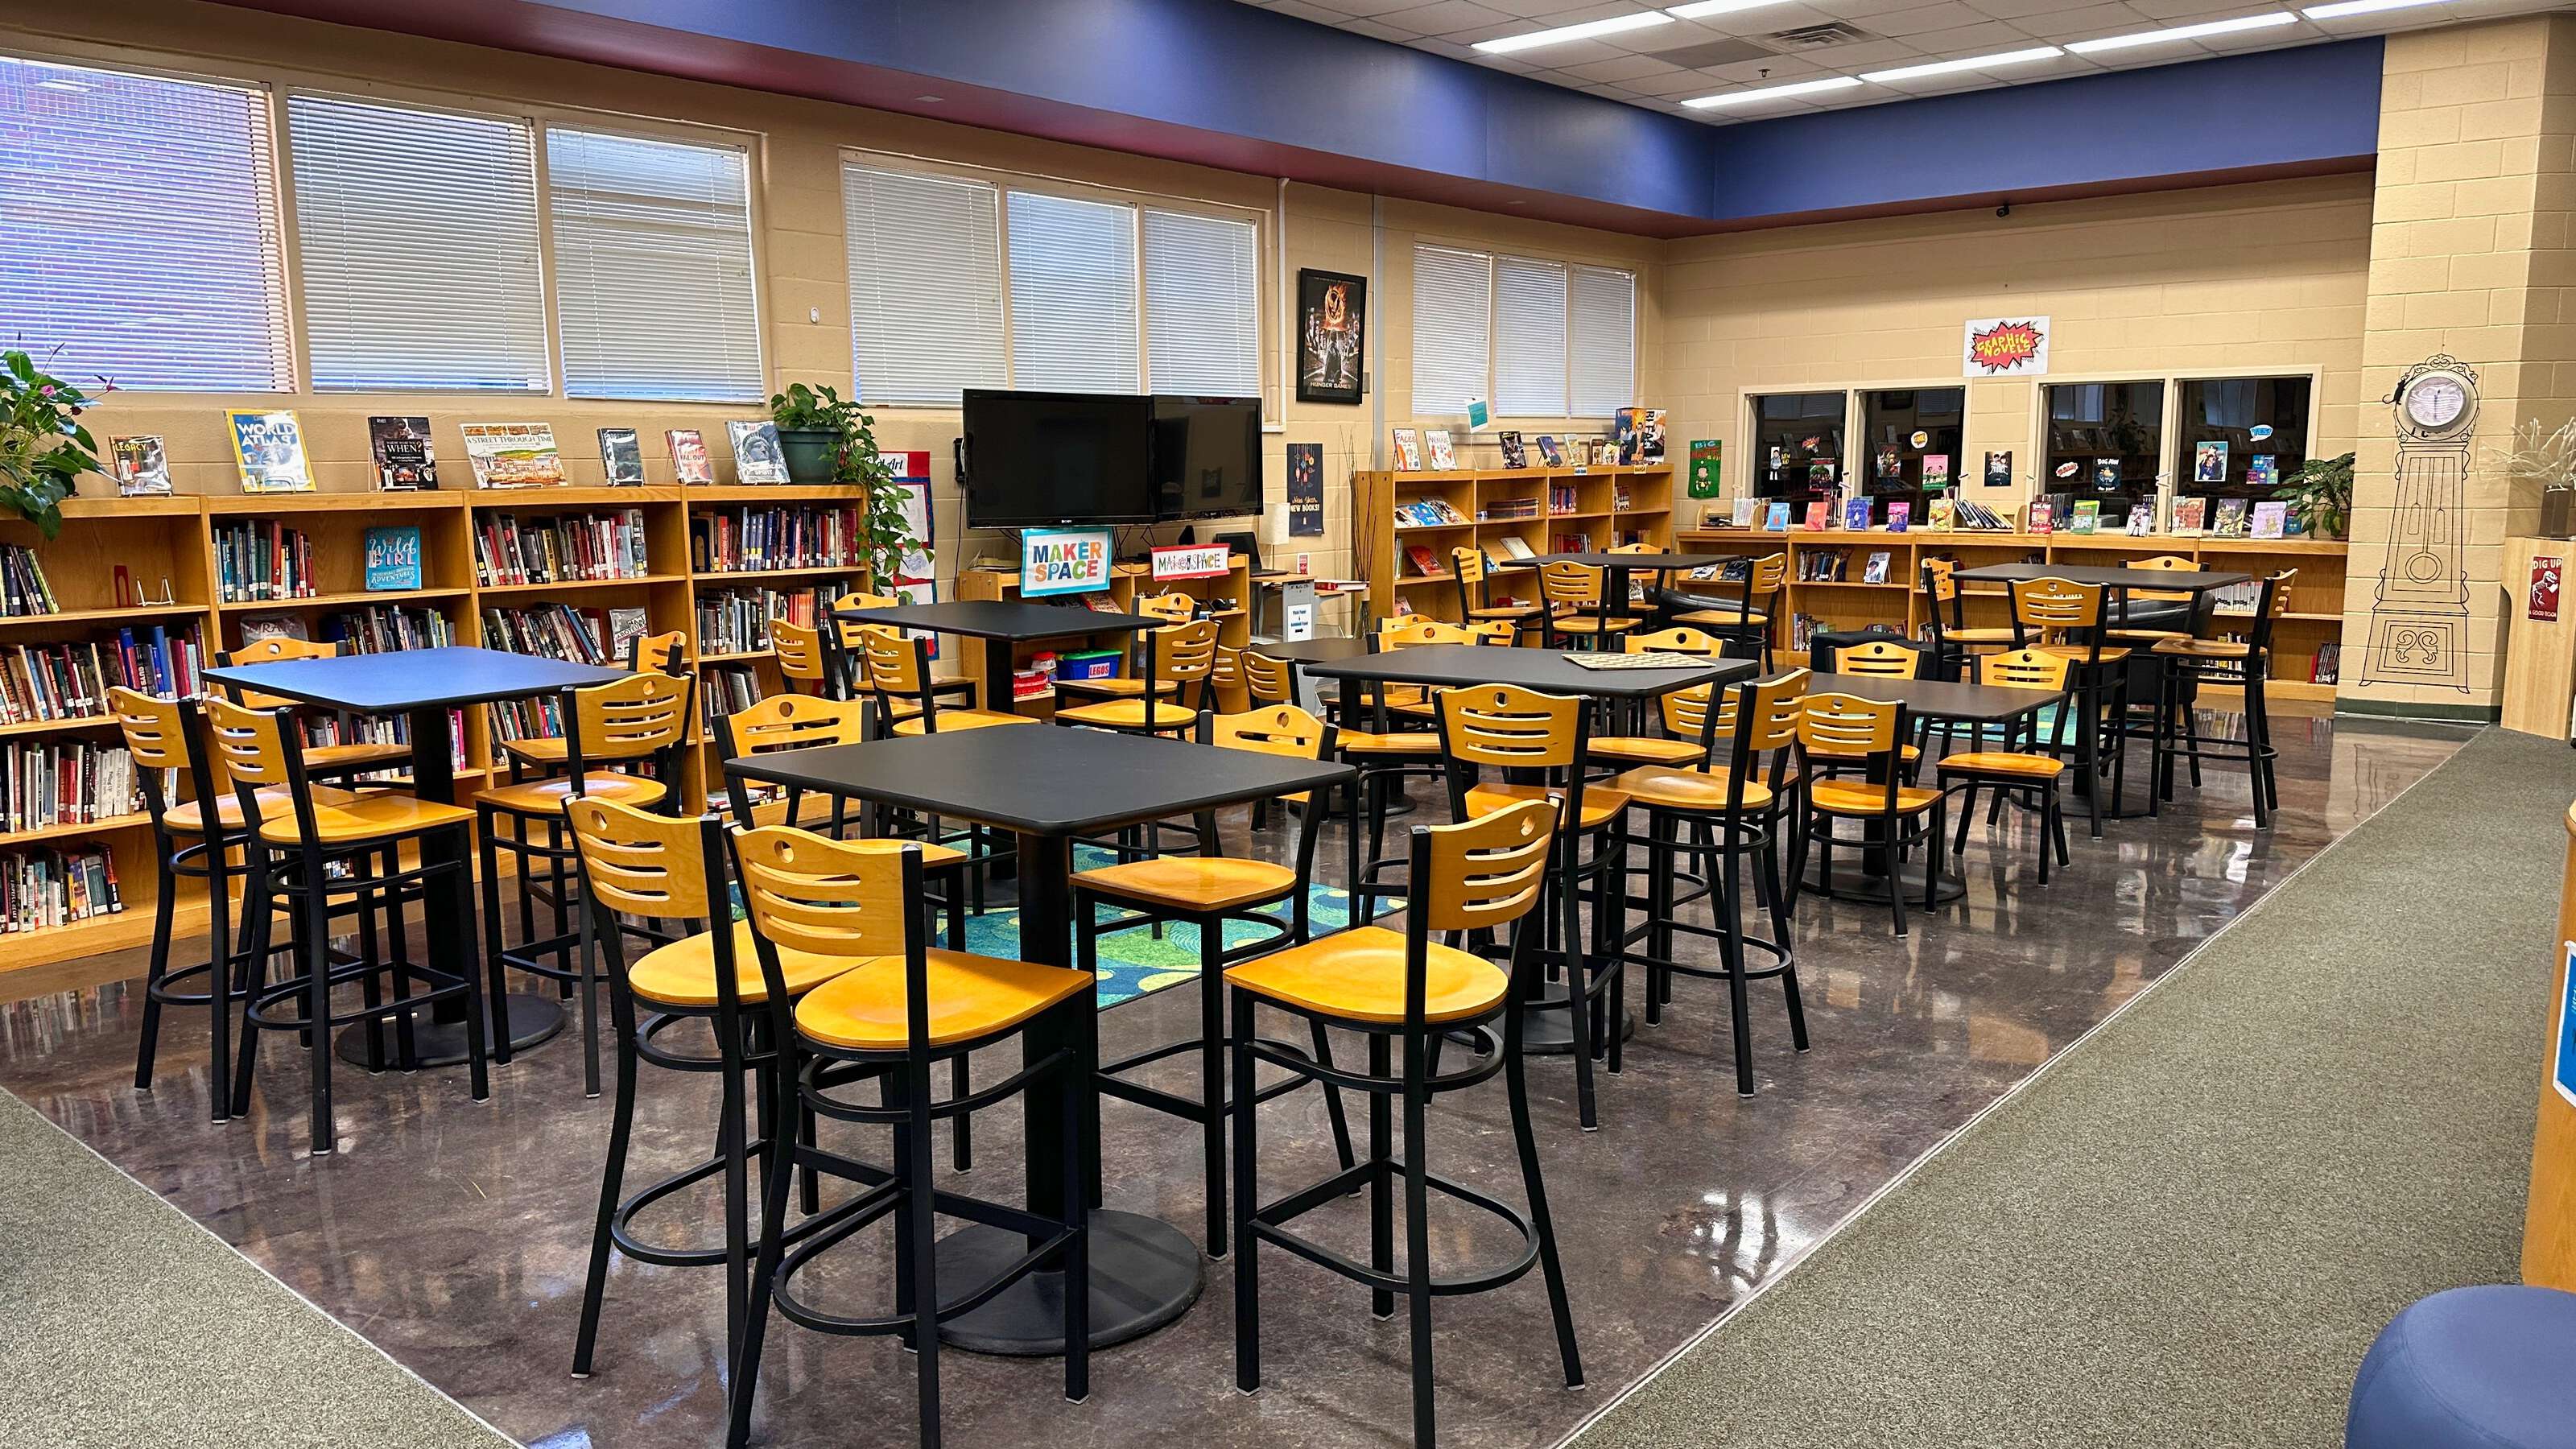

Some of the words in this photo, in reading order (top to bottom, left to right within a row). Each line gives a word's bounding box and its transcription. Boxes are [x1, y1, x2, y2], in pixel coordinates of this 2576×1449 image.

[1984, 338, 2031, 357] NOVELS
[237, 423, 295, 436] WORLD
[242, 434, 291, 446] ATLAS
[386, 440, 422, 452] WHEN?
[115, 443, 147, 452] LEGACY
[369, 537, 416, 555] Wild
[1033, 539, 1102, 564] MAKER
[2533, 559, 2548, 569] DIG
[2550, 559, 2562, 568] UP
[1034, 559, 1098, 582] SPACE
[1089, 665, 1109, 676] LEGOS
